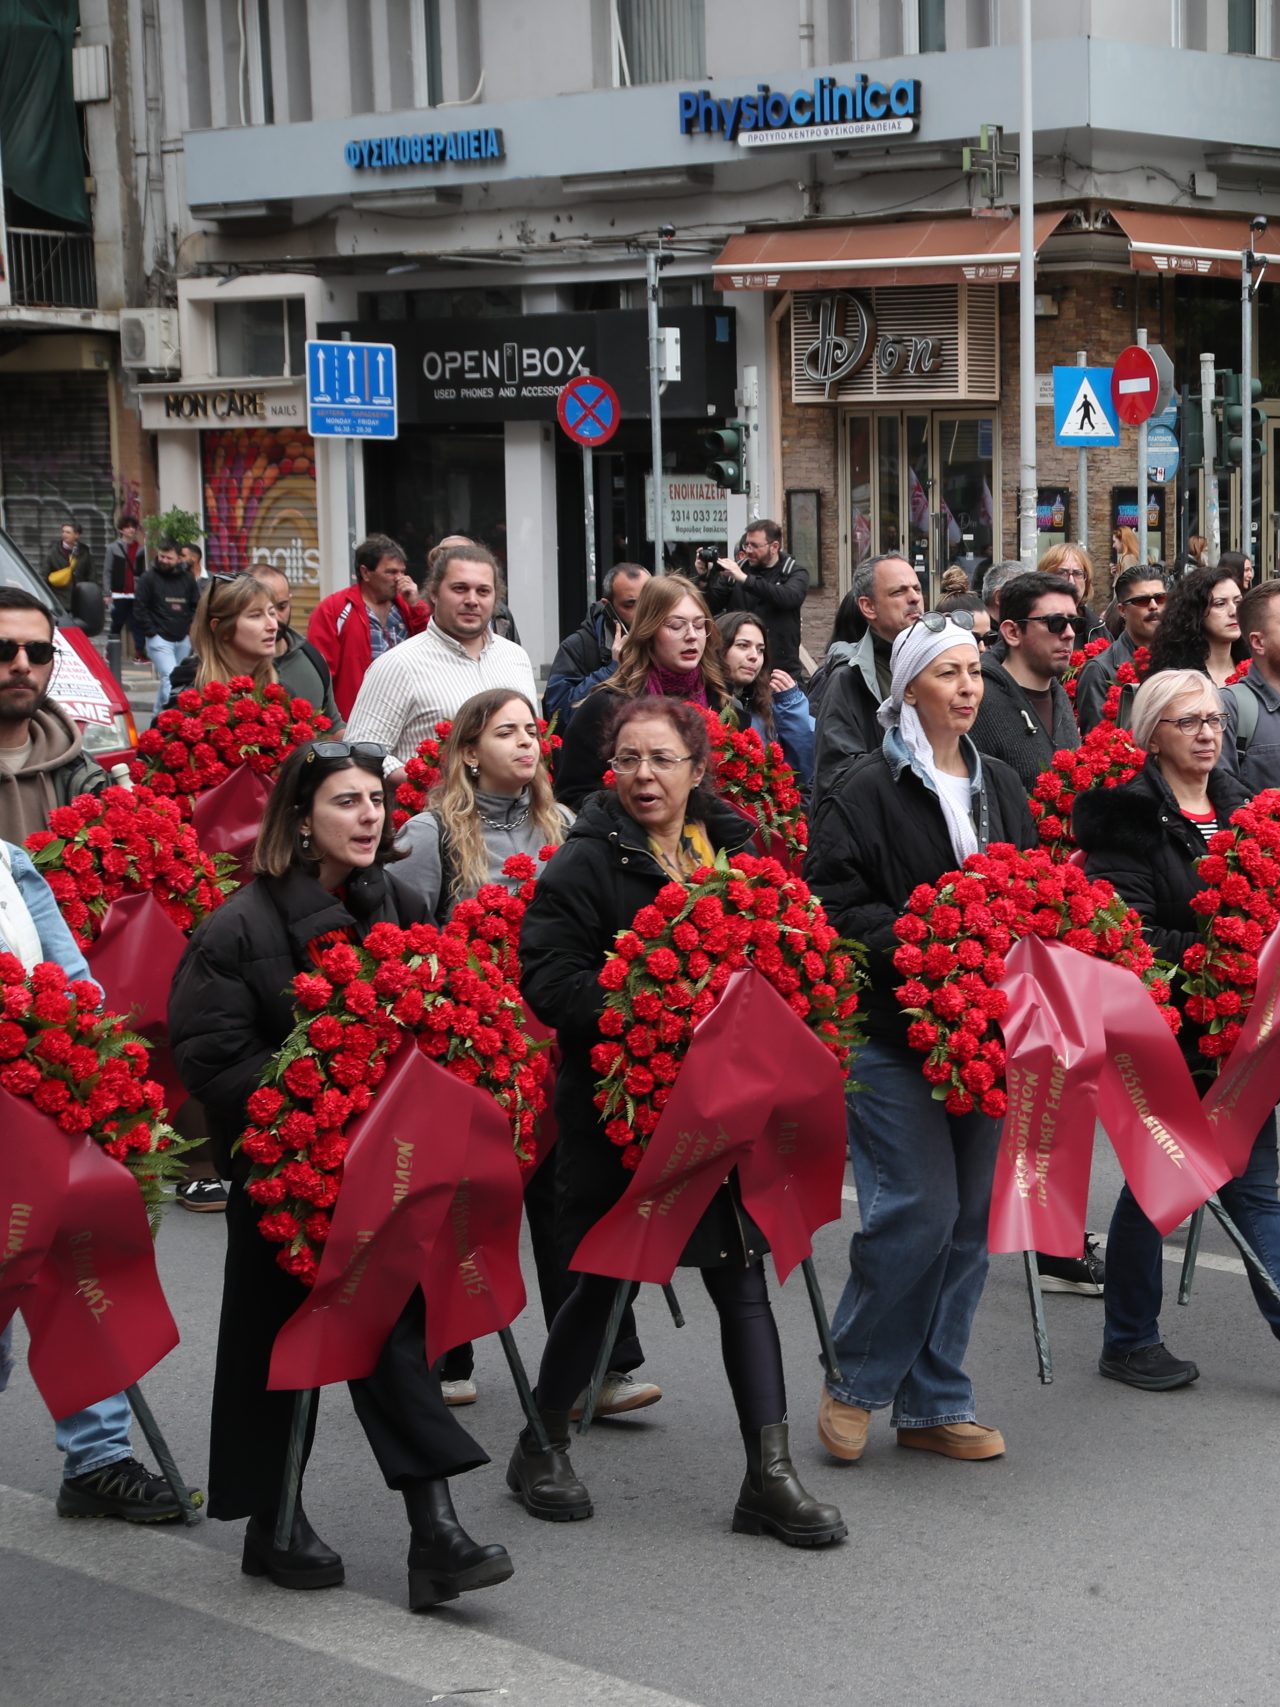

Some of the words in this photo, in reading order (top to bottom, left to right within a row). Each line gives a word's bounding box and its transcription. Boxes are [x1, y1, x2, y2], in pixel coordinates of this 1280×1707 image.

[679, 73, 920, 141] Physioclinica
[748, 131, 787, 143] ΠΡΟΤΥΠΟ
[788, 126, 822, 140] ΚΕΝΤΡΟ
[823, 121, 902, 137] ΦΥΣΙΚΟΘΕΡΑΠΕΙΑΣ
[344, 127, 503, 168] ΦΥΣΙΚΟΘΕΡΑΠΕΙΑ
[803, 291, 942, 400] Don
[423, 350, 500, 381] OPEN
[522, 346, 586, 377] BOX
[165, 393, 208, 417] MON
[434, 389, 457, 400] USED
[461, 387, 494, 398] PHONES
[499, 386, 516, 397] AND
[271, 405, 297, 416] NAILS
[671, 510, 690, 521] 2314
[693, 510, 710, 521] 033
[713, 510, 727, 521] 222
